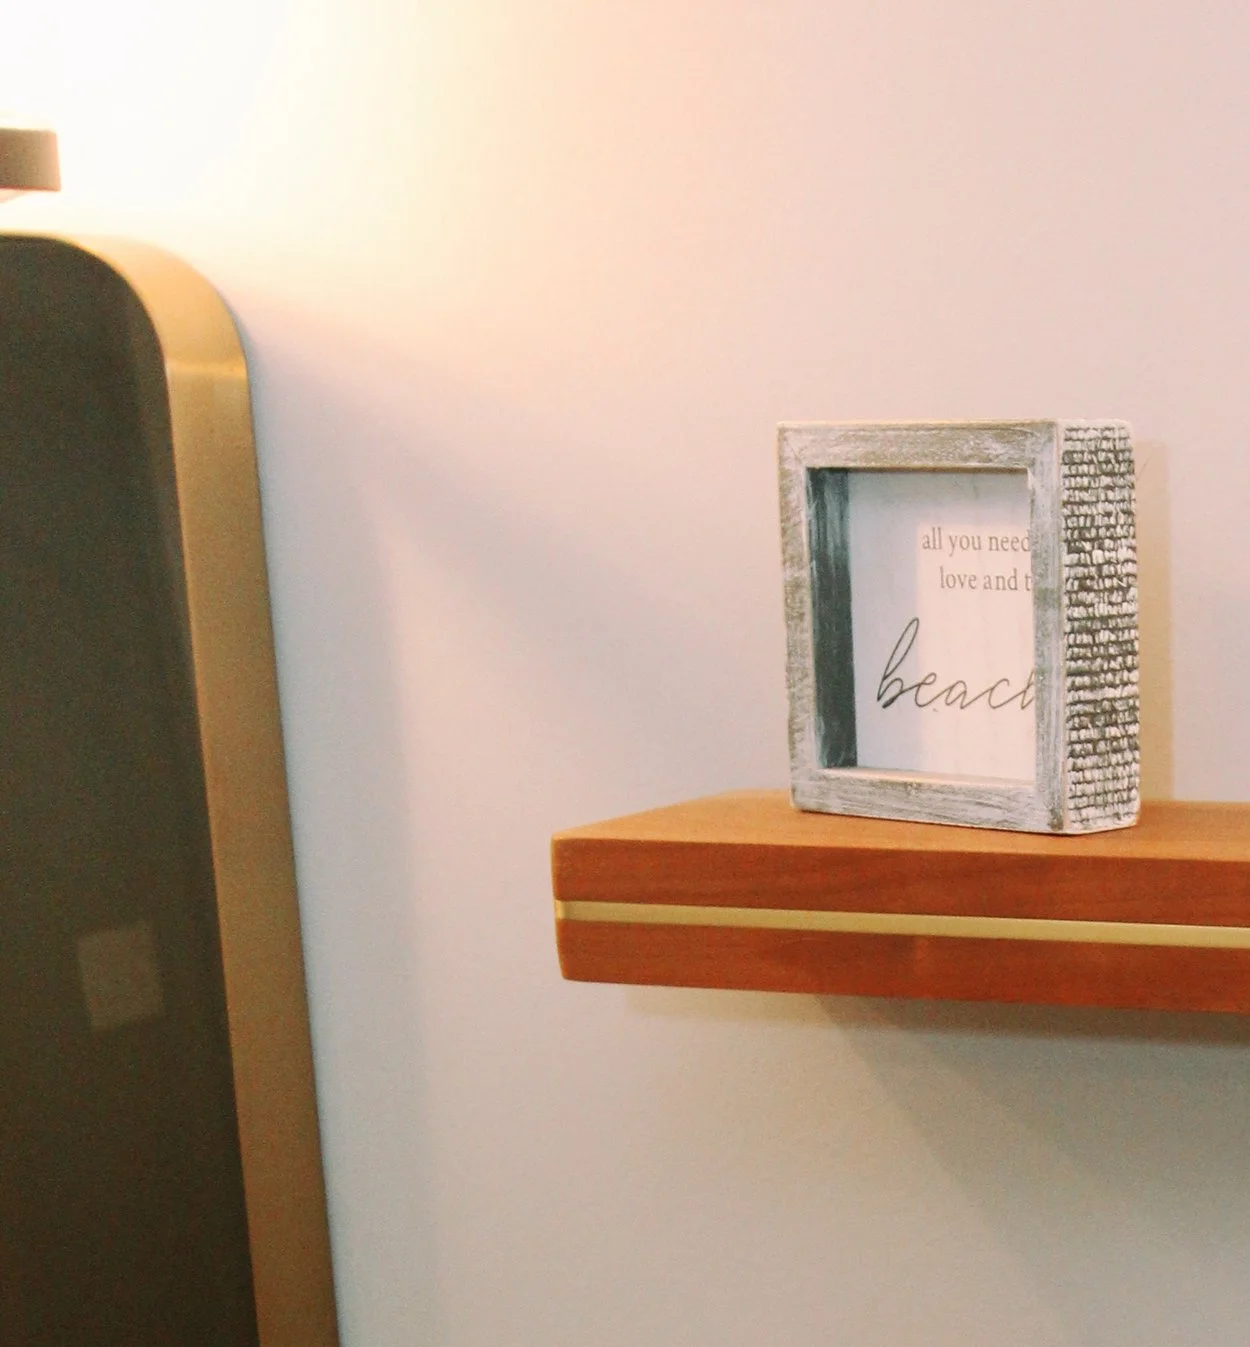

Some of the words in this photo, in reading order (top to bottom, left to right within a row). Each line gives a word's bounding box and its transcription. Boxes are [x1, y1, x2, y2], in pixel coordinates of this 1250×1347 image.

[921, 526, 942, 550] all
[948, 533, 982, 557] you
[939, 566, 978, 590] love
[983, 567, 1018, 591] and
